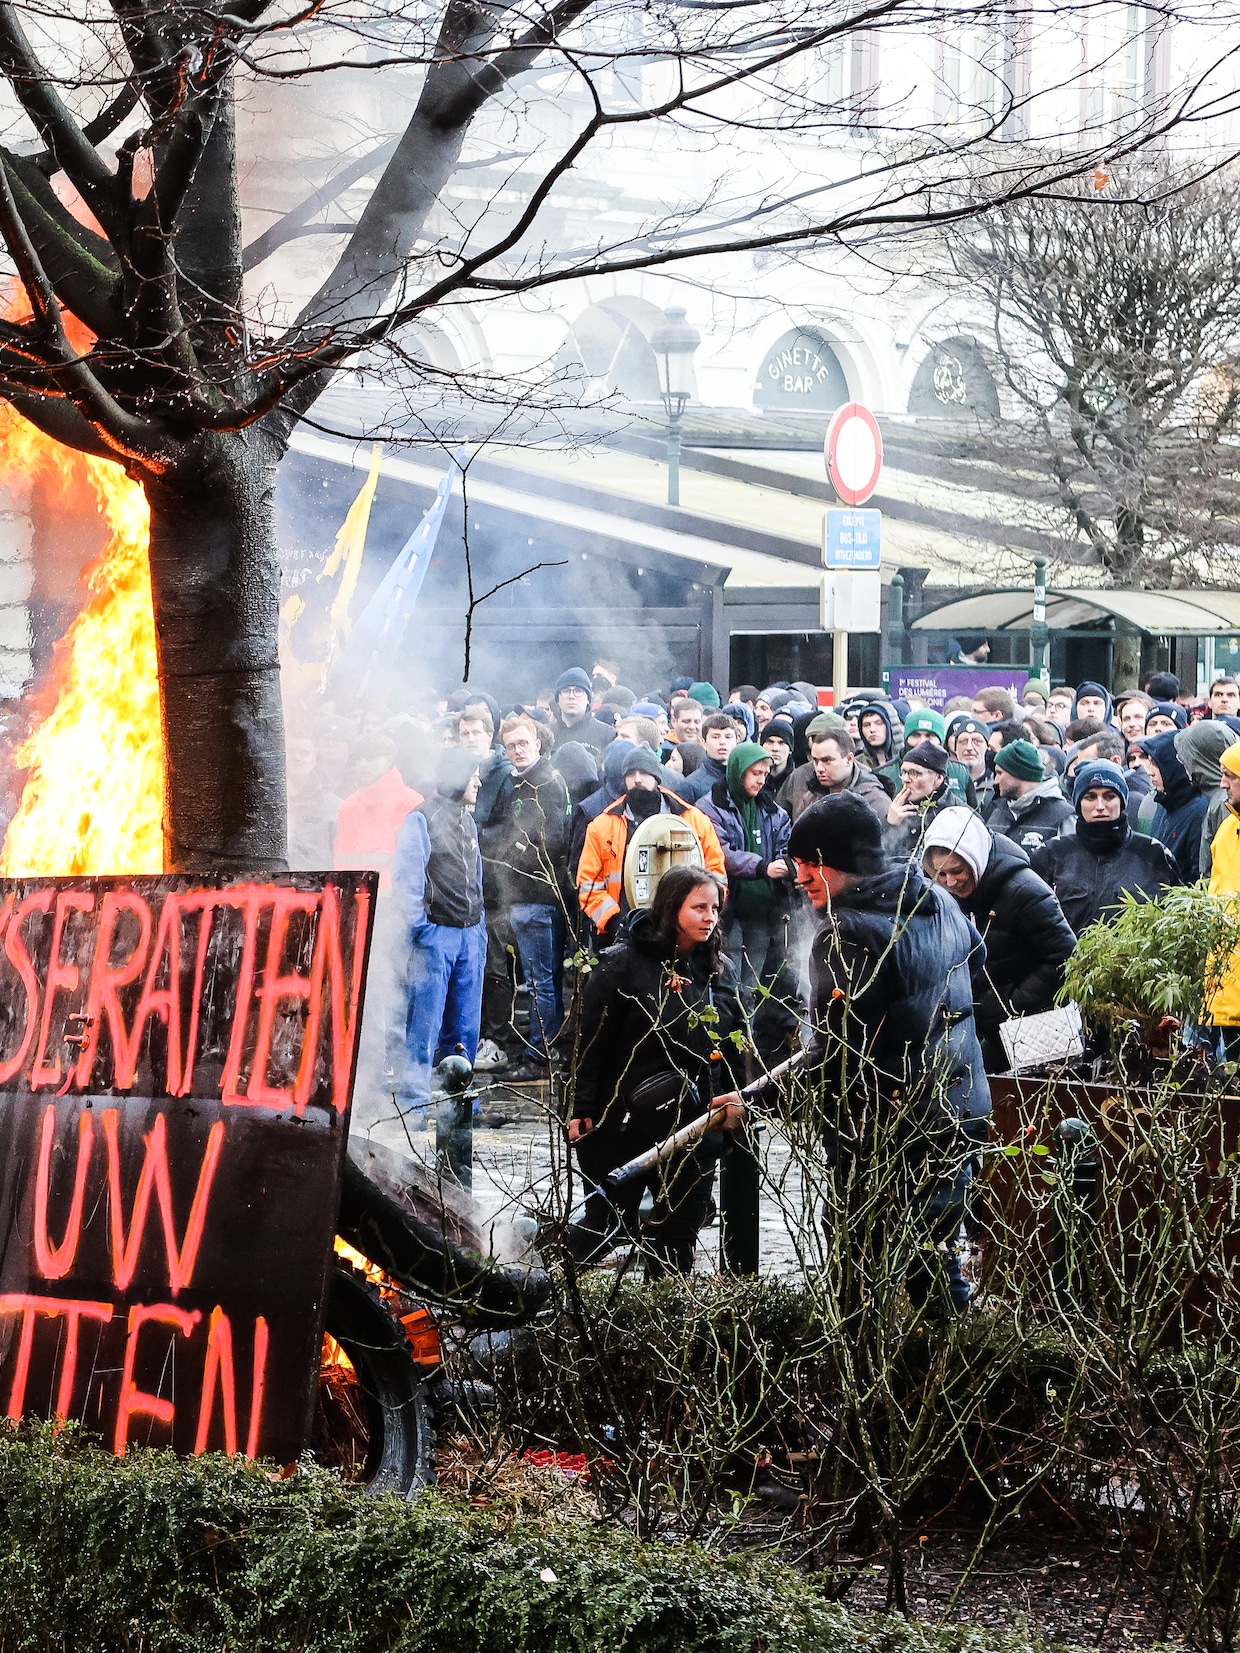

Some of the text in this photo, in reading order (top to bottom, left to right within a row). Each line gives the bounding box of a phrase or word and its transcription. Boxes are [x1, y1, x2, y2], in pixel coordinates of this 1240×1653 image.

[768, 347, 829, 384] GINETTE
[783, 374, 813, 393] BAR
[899, 687, 913, 697] DES
[907, 678, 937, 688] FESTIVAL
[34, 1104, 225, 1291] UW
